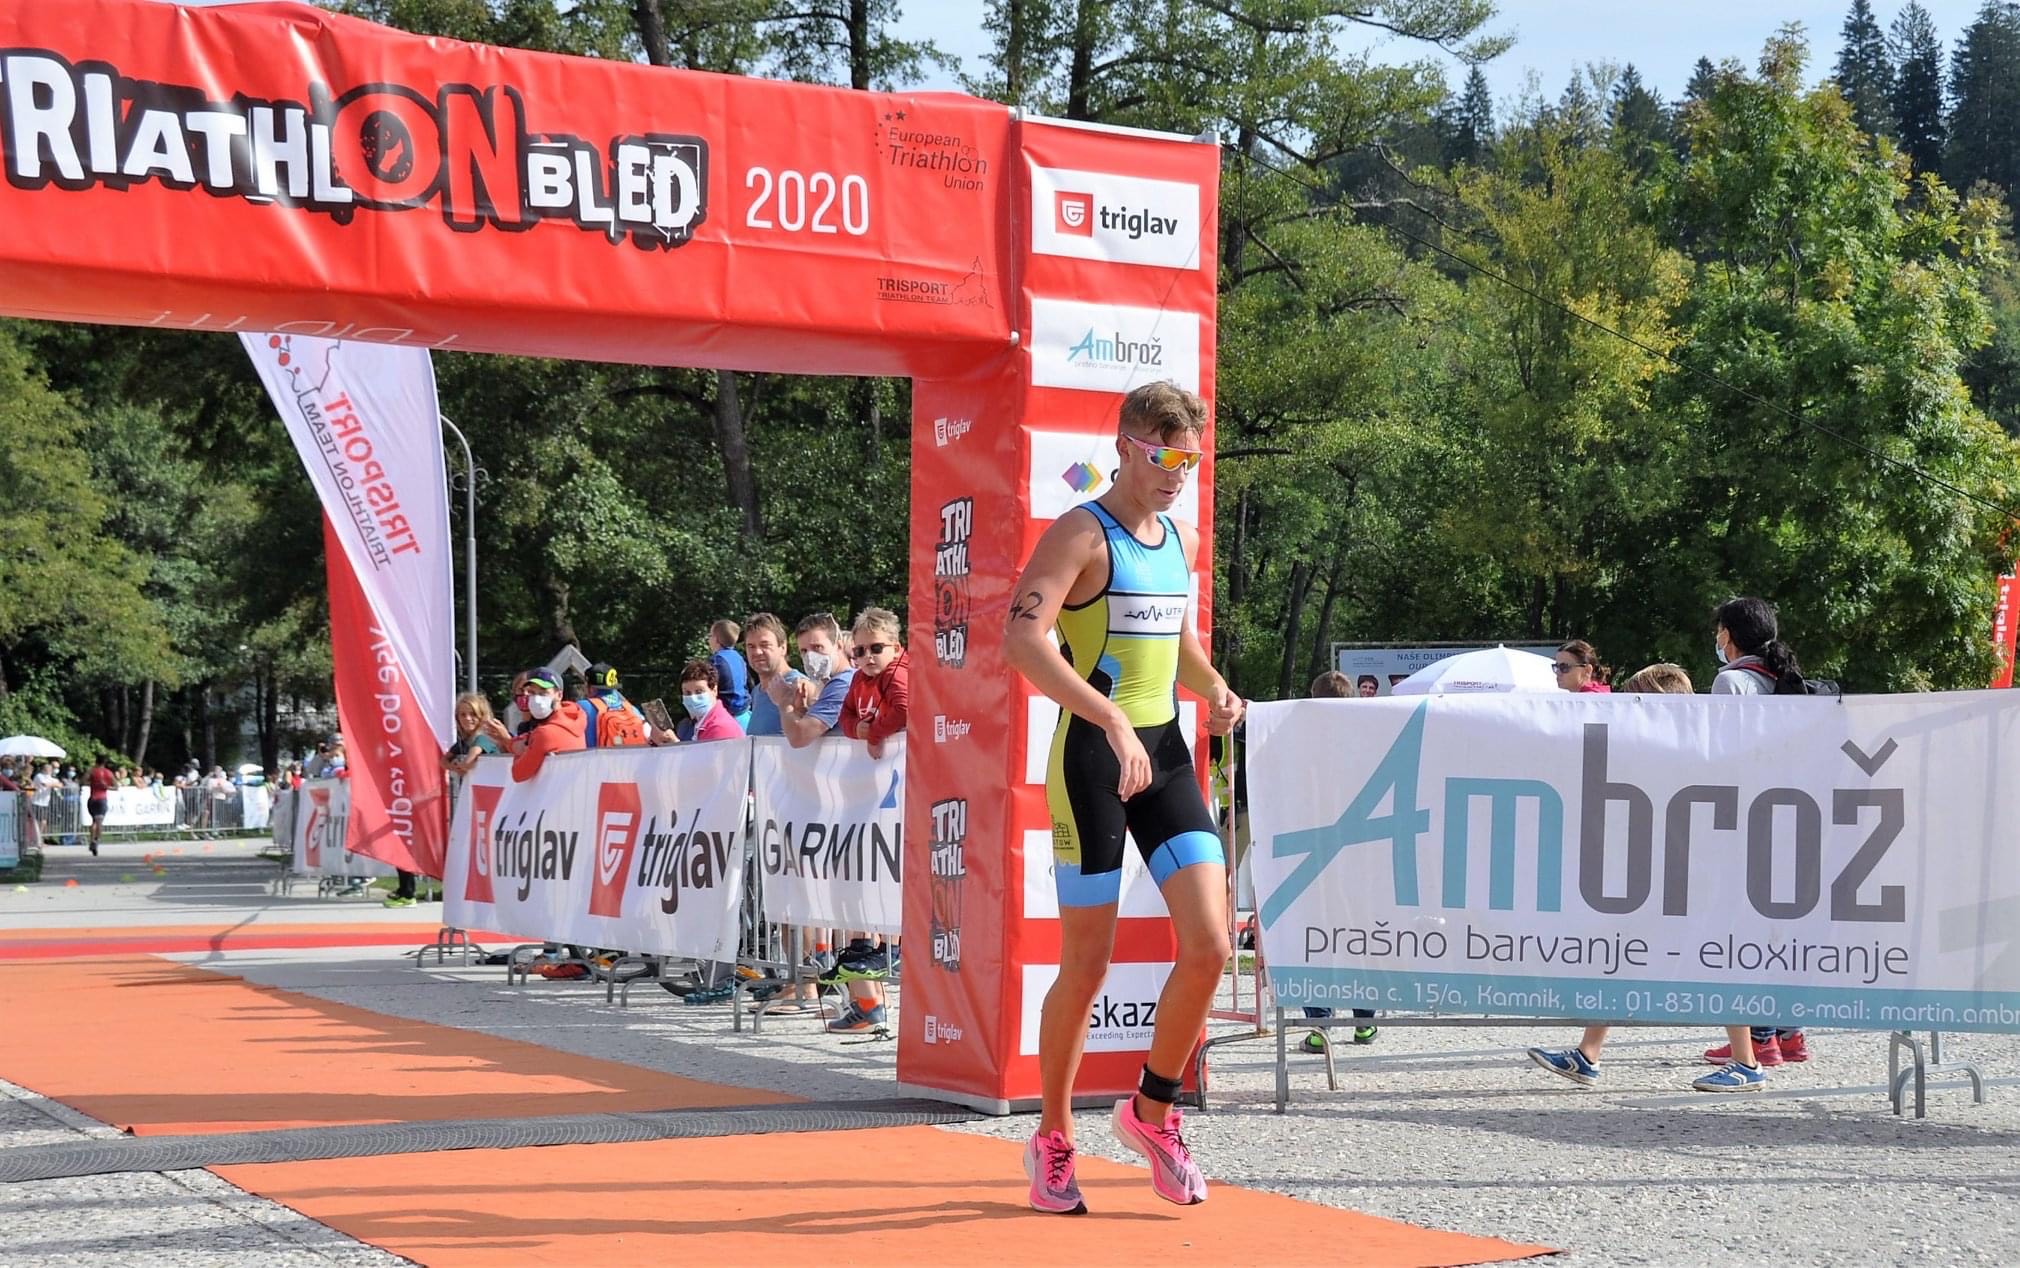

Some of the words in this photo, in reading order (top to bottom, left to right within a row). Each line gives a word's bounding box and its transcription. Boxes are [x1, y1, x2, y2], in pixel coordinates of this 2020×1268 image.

[0, 52, 520, 226] RIATHLON
[528, 142, 701, 234] BLED
[889, 127, 961, 147] European
[889, 144, 988, 174] Triathlon
[944, 175, 984, 191] Union
[745, 166, 870, 236] 2020
[1099, 203, 1178, 240] triglav
[877, 277, 948, 296] TRISPORT
[878, 292, 924, 301] TRIATHLON
[926, 295, 949, 303] TEAM
[1066, 326, 1162, 366] Ambrož
[946, 418, 972, 441] triglav
[941, 500, 972, 543] TRI
[936, 543, 968, 576] ATHL
[1009, 591, 1043, 622] 42
[936, 630, 966, 662] BLED
[946, 719, 971, 740] triglav
[932, 800, 967, 843] TRI
[1259, 698, 1906, 931] Ambrož
[494, 808, 579, 902] triglav
[637, 807, 735, 915] triglav
[762, 818, 901, 883] GARMIN
[931, 844, 966, 876] ATHL
[1305, 922, 1448, 964] prašno
[1466, 925, 1648, 976] barvanje
[1699, 932, 1910, 984] eloxiranje
[1387, 986, 1403, 1001] c.
[1414, 983, 1468, 1008] 15/a,
[1478, 985, 1565, 1011] Kamnik,
[1575, 989, 1617, 1011] tel.:
[1625, 991, 1724, 1015] 01-8310
[1731, 994, 1782, 1019] 460,
[1791, 999, 1871, 1021] e-mail:
[937, 1023, 963, 1044] triglav
